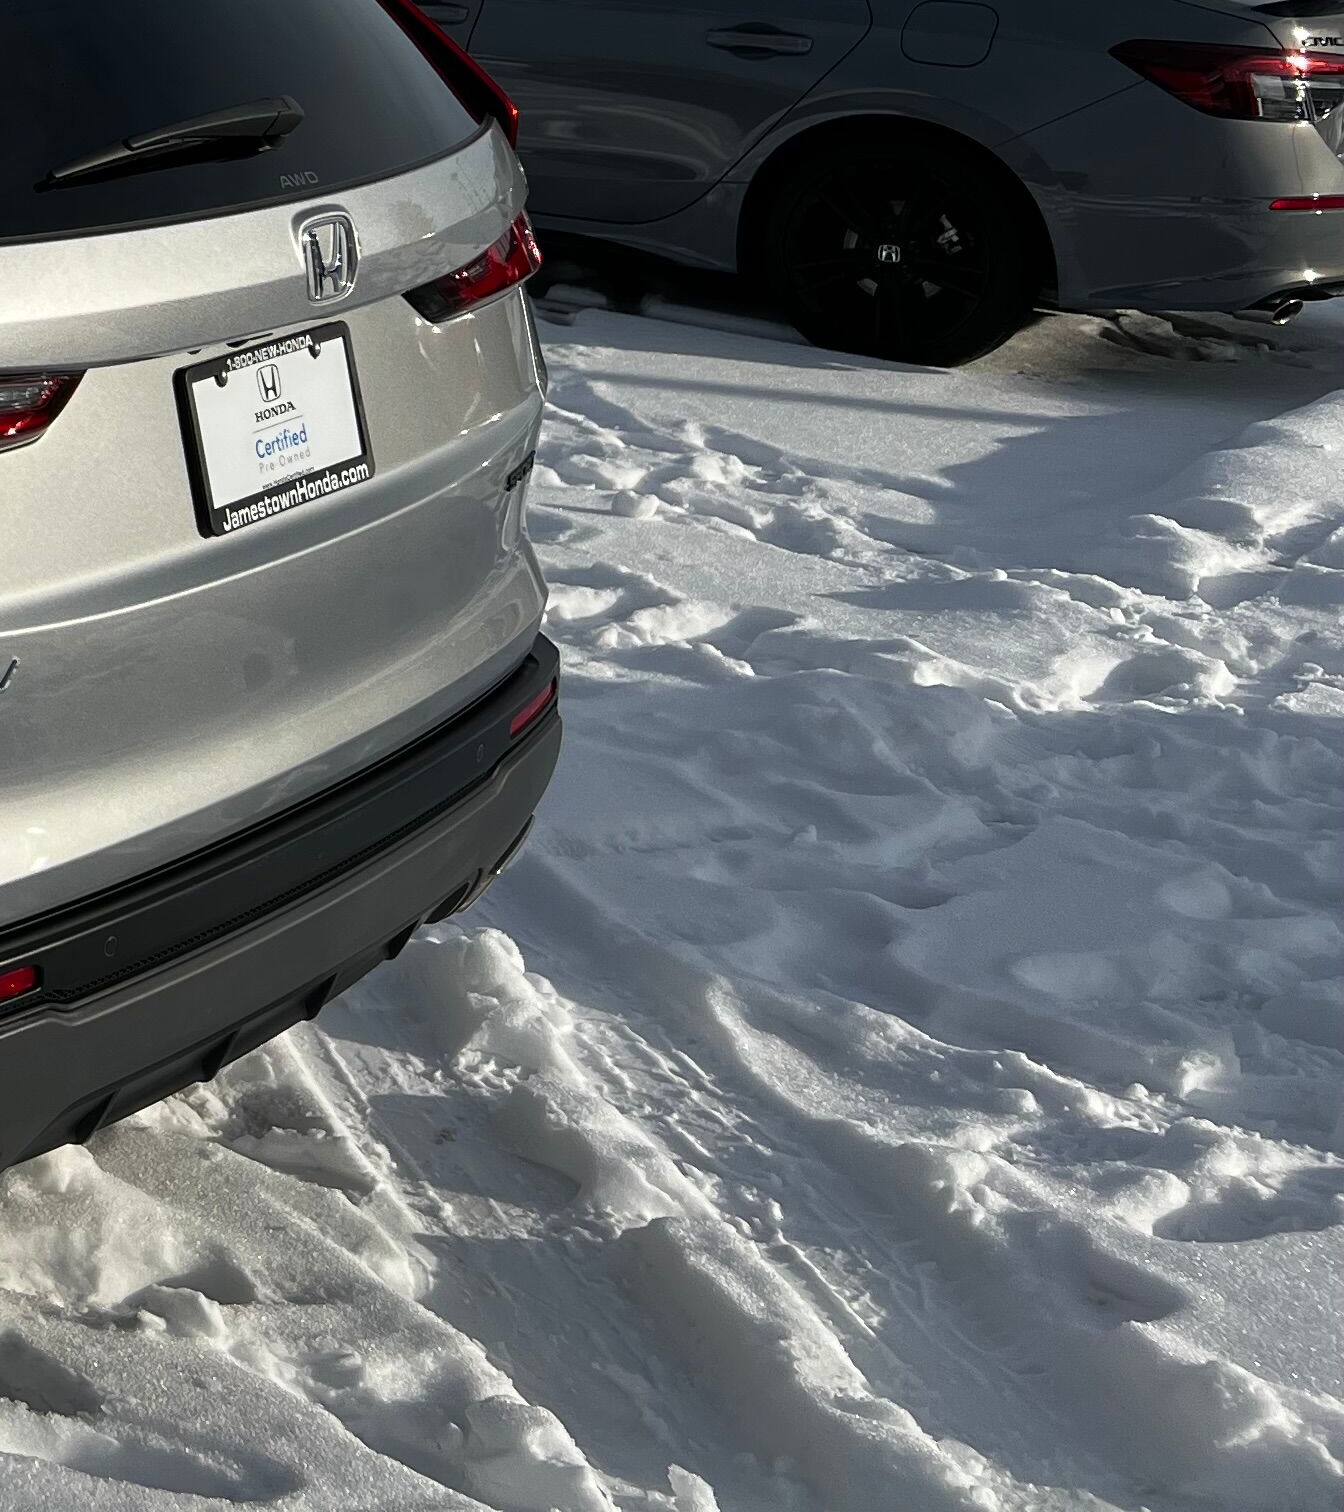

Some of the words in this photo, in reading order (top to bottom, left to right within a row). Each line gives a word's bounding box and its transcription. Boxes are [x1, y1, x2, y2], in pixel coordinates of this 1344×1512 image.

[279, 171, 319, 189] AWD
[226, 334, 314, 371] 1-800-NEW-HONDA
[254, 400, 297, 423] HONDA
[255, 422, 308, 459] Certified
[258, 461, 275, 474] Pre
[278, 445, 311, 467] Owned
[222, 462, 370, 532] JamestownHonda.com
